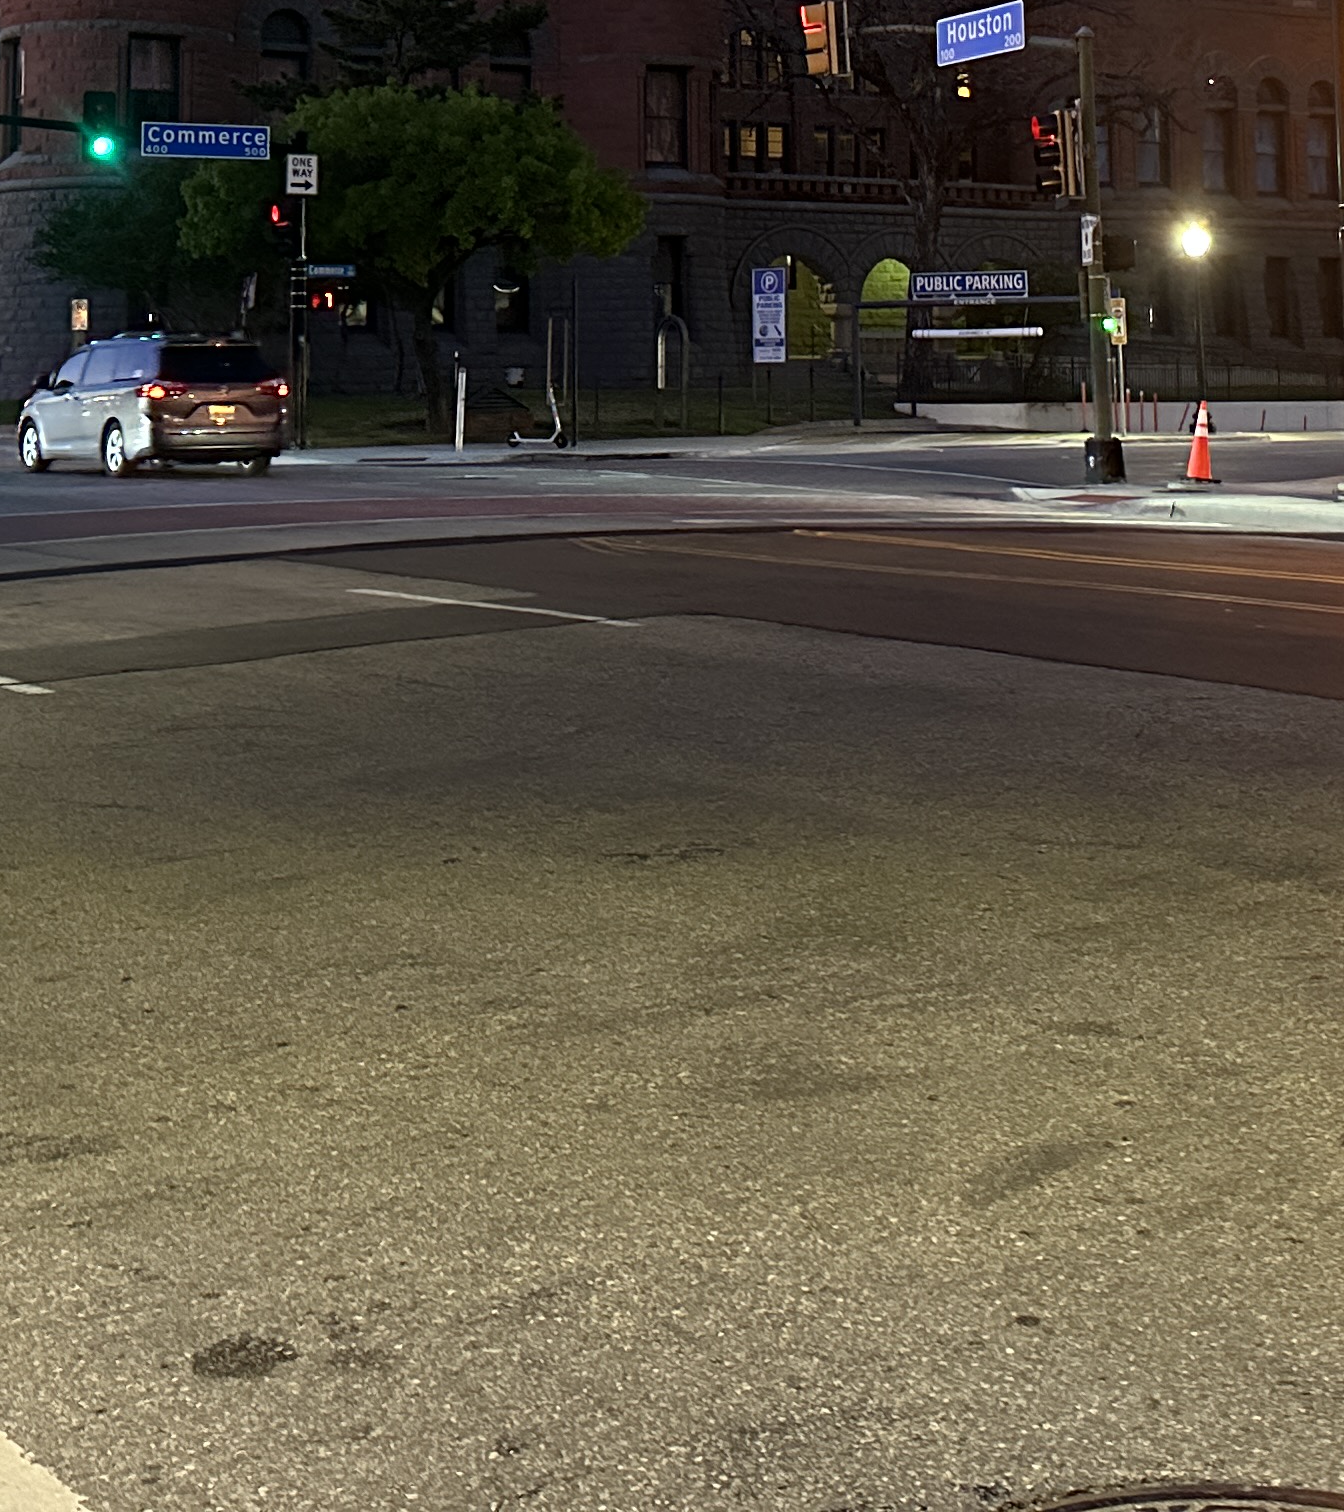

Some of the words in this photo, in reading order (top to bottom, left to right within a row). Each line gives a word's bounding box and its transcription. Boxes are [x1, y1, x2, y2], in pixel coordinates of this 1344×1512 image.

[947, 12, 1012, 44] Houston
[1004, 33, 1021, 47] 200
[941, 48, 954, 60] 100
[147, 126, 266, 146] Commerce
[145, 144, 168, 154] 400
[244, 147, 266, 156] 500
[292, 157, 312, 168] ONE
[292, 168, 313, 178] WAY
[765, 275, 774, 289] P
[916, 275, 962, 291] PUBLIC
[965, 274, 1023, 290] PARKING
